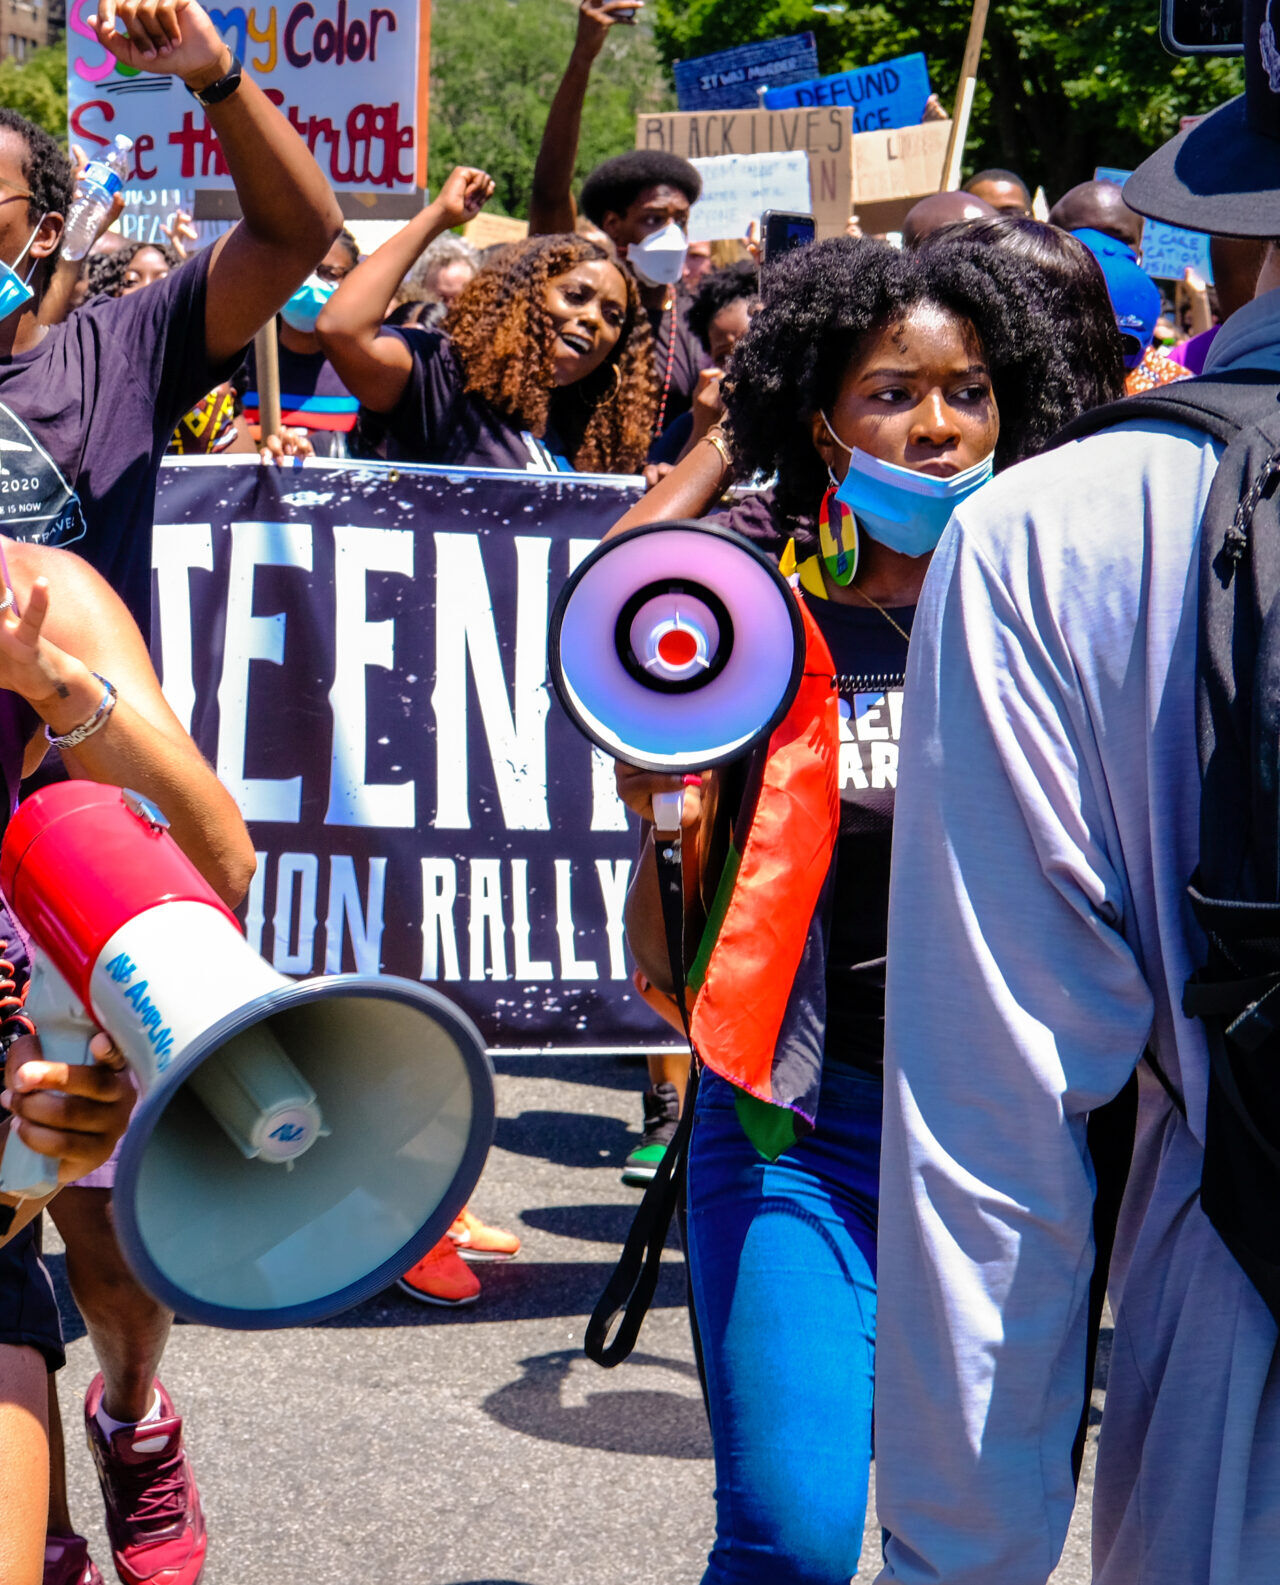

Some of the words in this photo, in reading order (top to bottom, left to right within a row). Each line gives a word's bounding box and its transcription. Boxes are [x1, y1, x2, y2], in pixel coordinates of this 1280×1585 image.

[284, 0, 397, 68] Color
[747, 57, 798, 79] MURDER
[795, 67, 900, 108] DEFUND
[70, 100, 158, 182] Se
[168, 111, 232, 178] th
[263, 88, 414, 187] truggle
[645, 114, 736, 153] BLACK
[750, 108, 842, 153] LIVES
[854, 106, 893, 133] ICE
[1, 477, 40, 494] 2020
[7, 504, 16, 514] IS
[18, 501, 42, 513] NOW
[420, 857, 632, 982] RALLY
